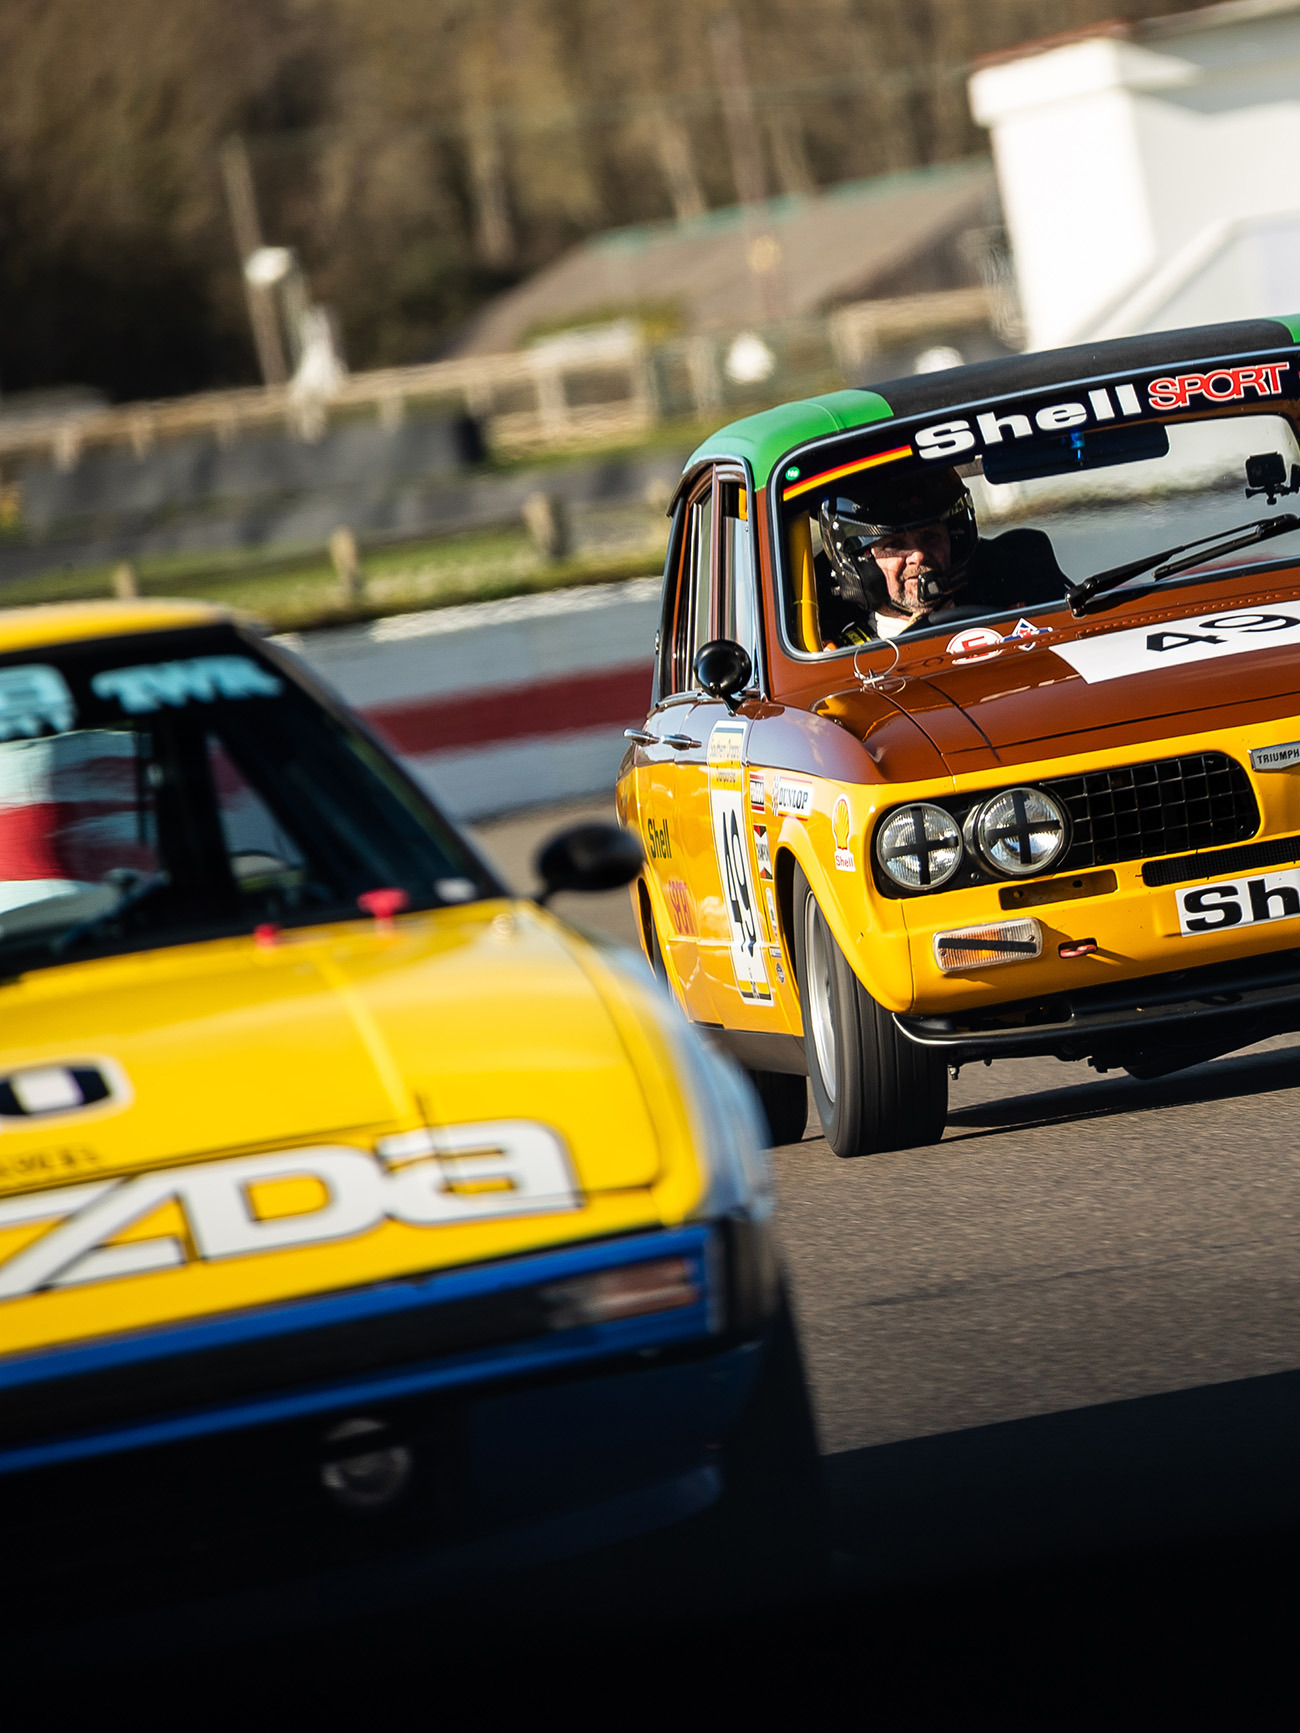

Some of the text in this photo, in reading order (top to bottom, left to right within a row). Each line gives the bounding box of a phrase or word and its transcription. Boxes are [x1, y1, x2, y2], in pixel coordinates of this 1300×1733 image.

[914, 361, 1290, 460] Shell SPORT
[1257, 748, 1300, 765] TRIUMPH
[778, 786, 809, 810] DUNLOP
[647, 818, 672, 859] Shell
[835, 856, 854, 868] Shell
[722, 809, 757, 958] 49
